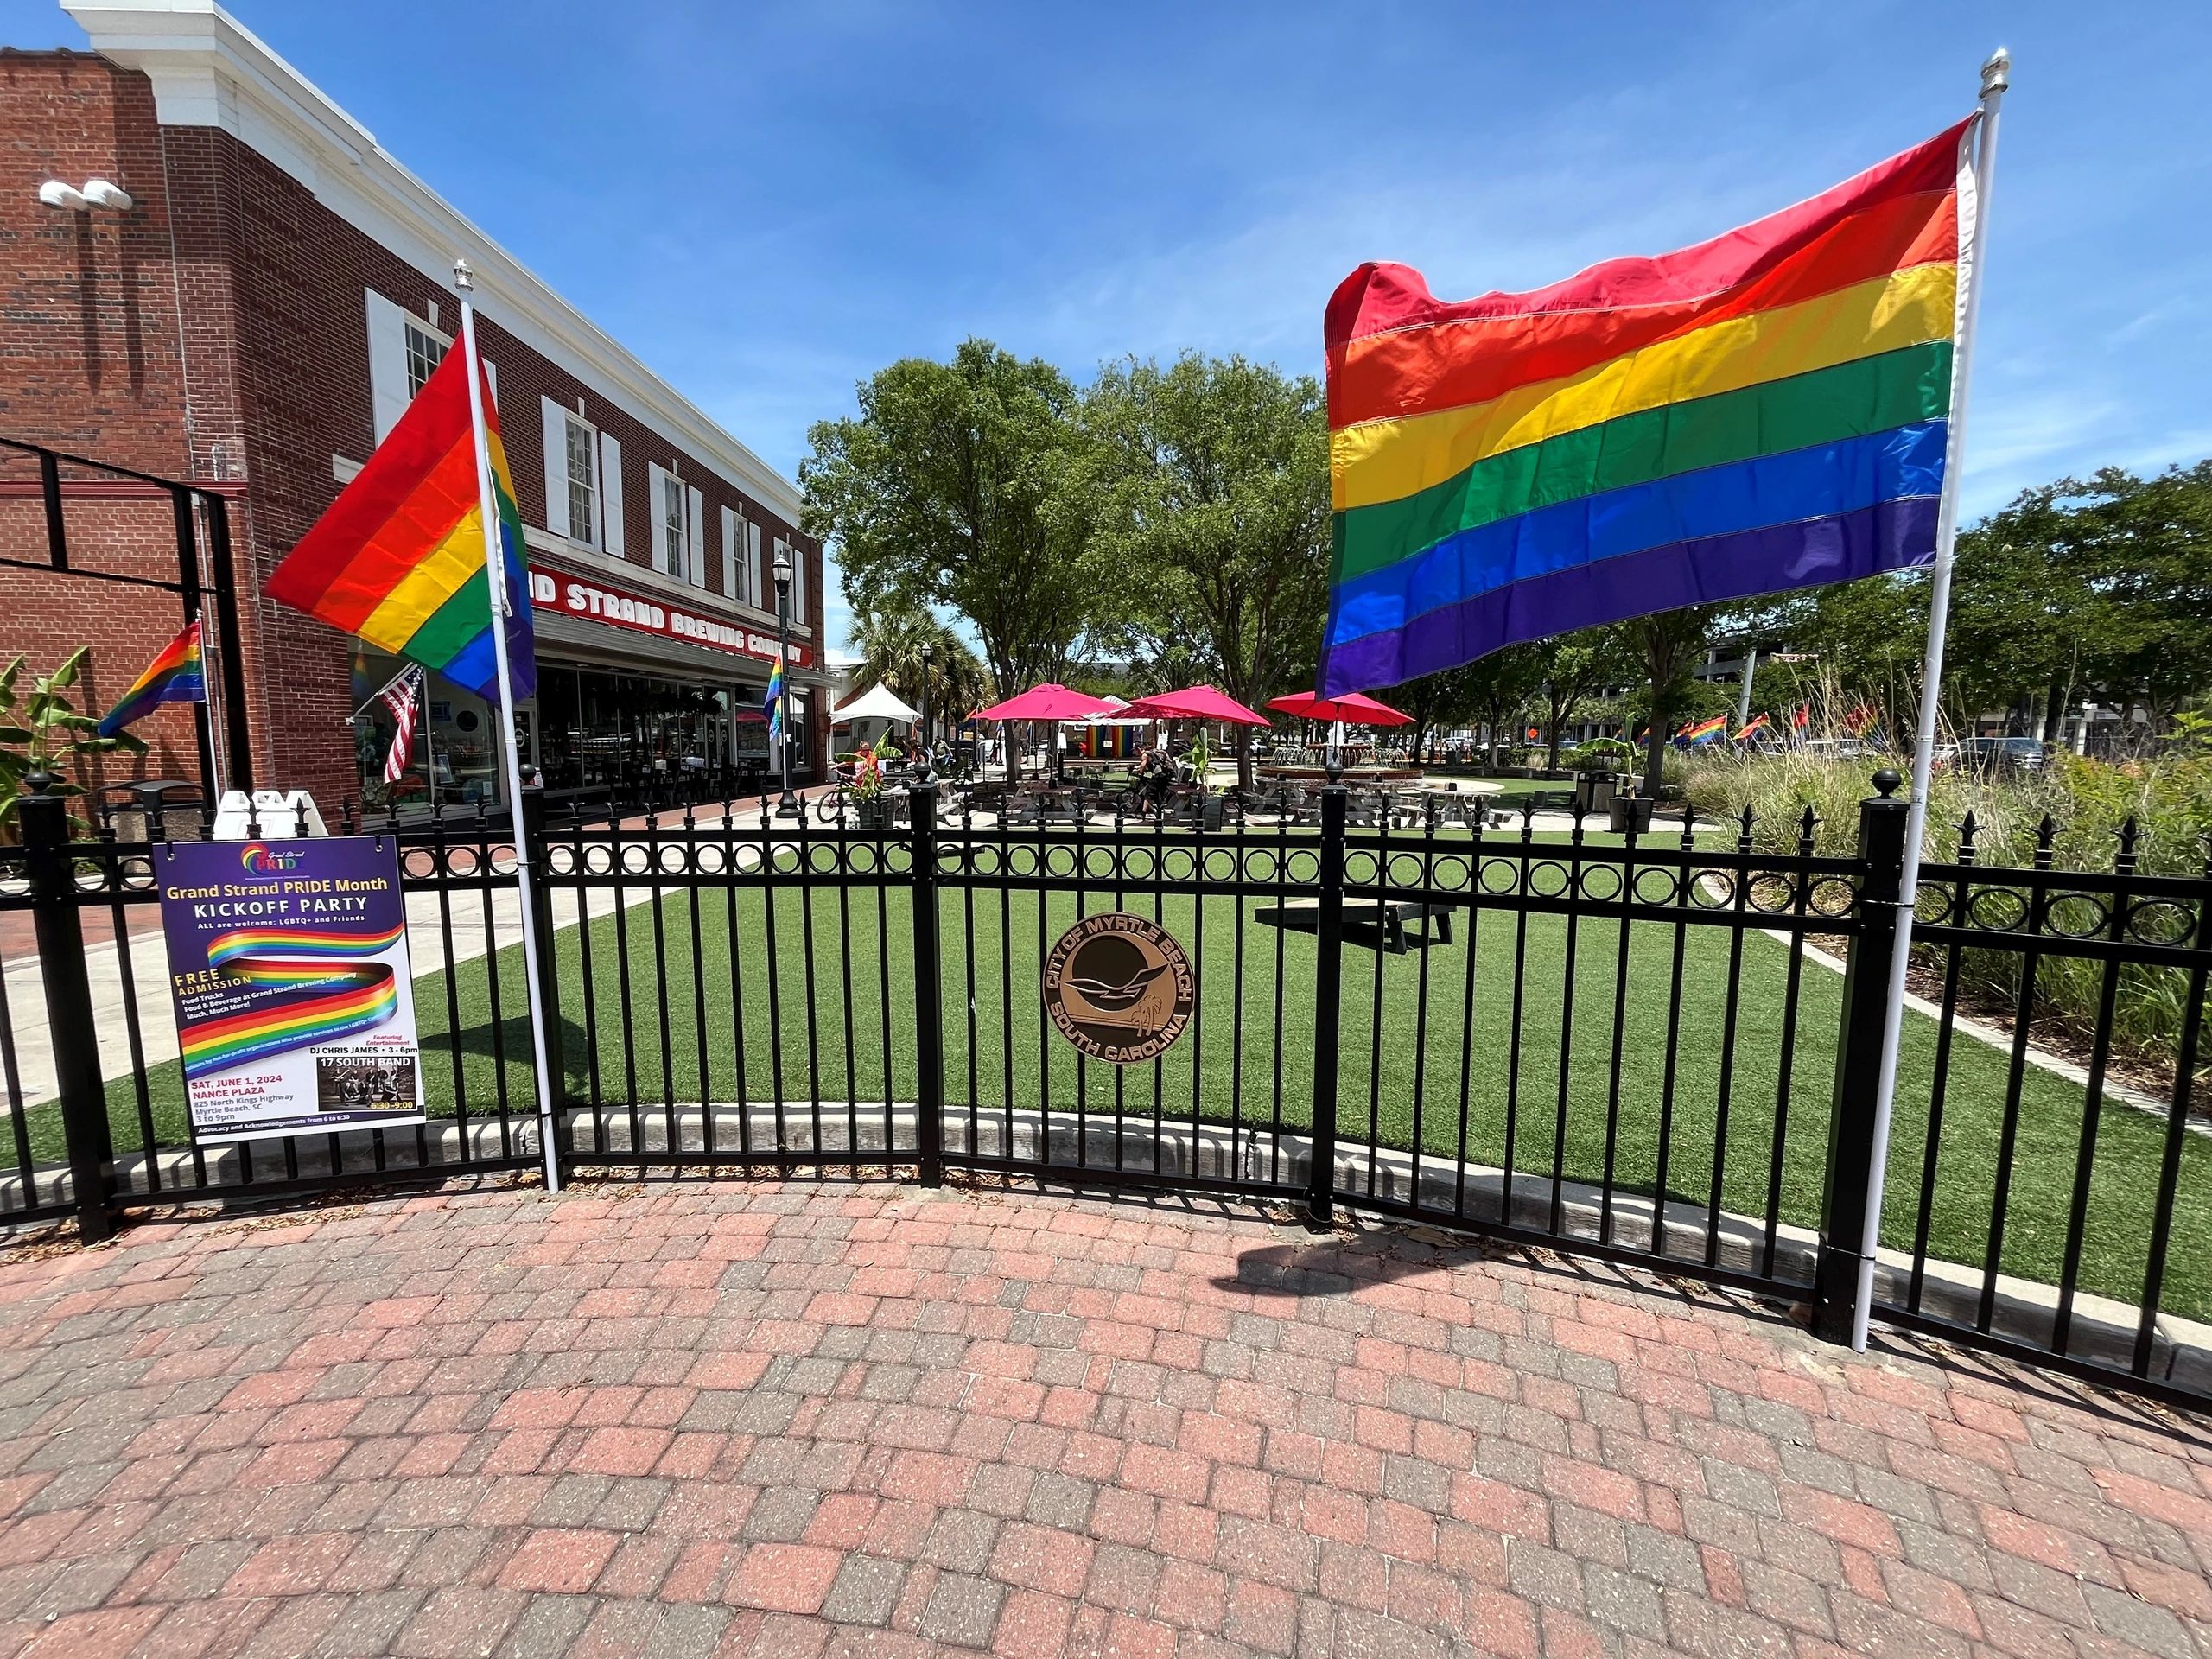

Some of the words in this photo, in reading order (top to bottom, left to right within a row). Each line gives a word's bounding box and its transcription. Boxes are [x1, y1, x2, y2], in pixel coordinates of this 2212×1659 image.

[567, 584, 664, 628] STRAND
[671, 613, 744, 648] BREWING
[747, 634, 802, 662] COMPNY
[167, 884, 219, 899] Grand
[223, 882, 279, 897] Strand
[283, 880, 331, 894] PRIDE
[335, 877, 388, 892] Month
[194, 900, 289, 918] KICKOFF
[300, 897, 367, 912] PARTY
[1046, 946, 1067, 989] CITY
[1061, 926, 1084, 950] OF
[1085, 916, 1160, 943] MYRTLE
[1158, 938, 1192, 1002] BEACH
[175, 969, 220, 987] FREE
[178, 976, 251, 996] ADMISSION
[209, 995, 242, 1007] Beverage
[251, 988, 273, 998] Grand
[273, 984, 296, 994] Strand
[297, 978, 326, 988] Brewing
[326, 972, 357, 983] Company
[181, 997, 200, 1006] Food
[200, 992, 225, 1001] Trucks
[209, 1006, 230, 1015] Much
[230, 1001, 251, 1010] More!
[1051, 1001, 1101, 1055] SOUTH
[1104, 1014, 1188, 1061] CAROLINA
[321, 1058, 334, 1067] 17
[336, 1058, 375, 1066] SOUTH
[378, 1057, 410, 1066] BAND
[216, 1078, 242, 1088] JUNE
[257, 1075, 283, 1084] 2024
[193, 1090, 229, 1099] NANCE
[232, 1087, 264, 1096] PLAZA
[210, 1097, 234, 1106] North
[259, 1094, 294, 1103] Highway
[195, 1107, 222, 1116] Myrtle
[215, 1114, 235, 1122] 9pm
[198, 1125, 230, 1134] Advocacy
